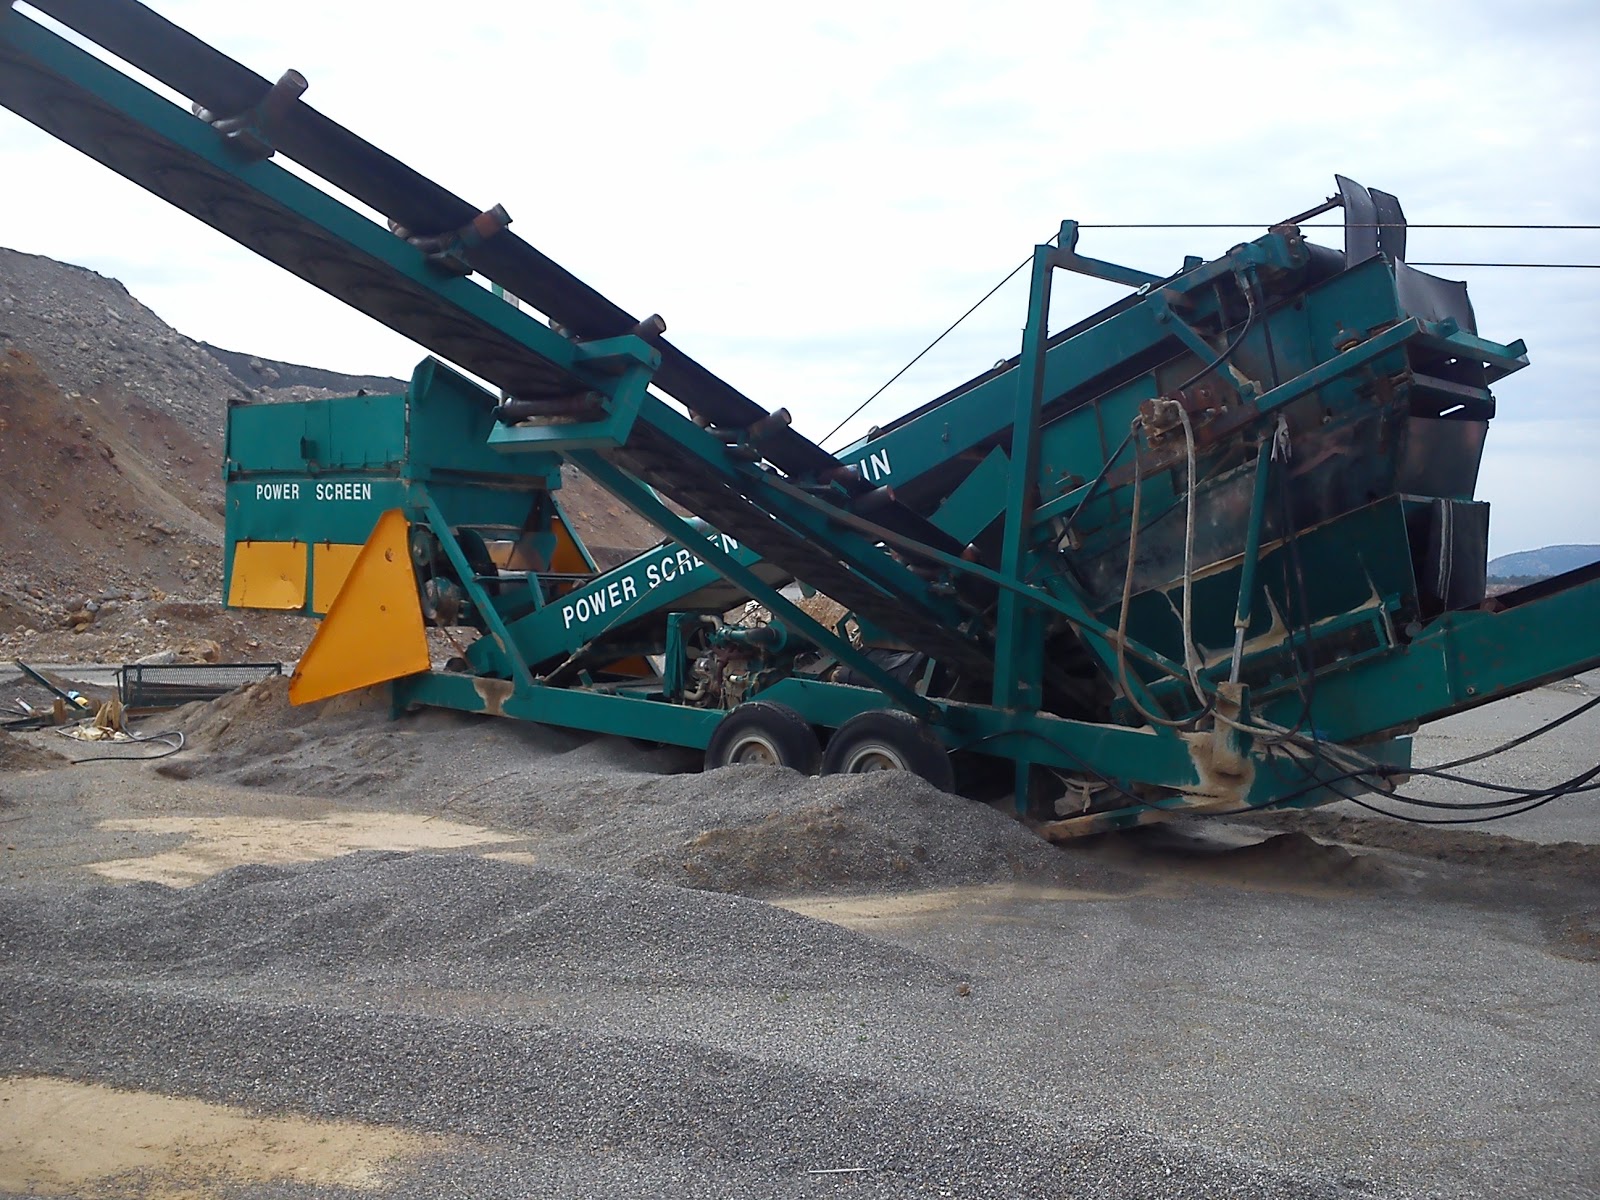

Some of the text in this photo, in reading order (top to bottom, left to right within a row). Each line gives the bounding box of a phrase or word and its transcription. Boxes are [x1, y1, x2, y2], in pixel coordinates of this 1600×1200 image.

[256, 483, 371, 500] POWER SCREEN
[562, 575, 637, 629] POWER
